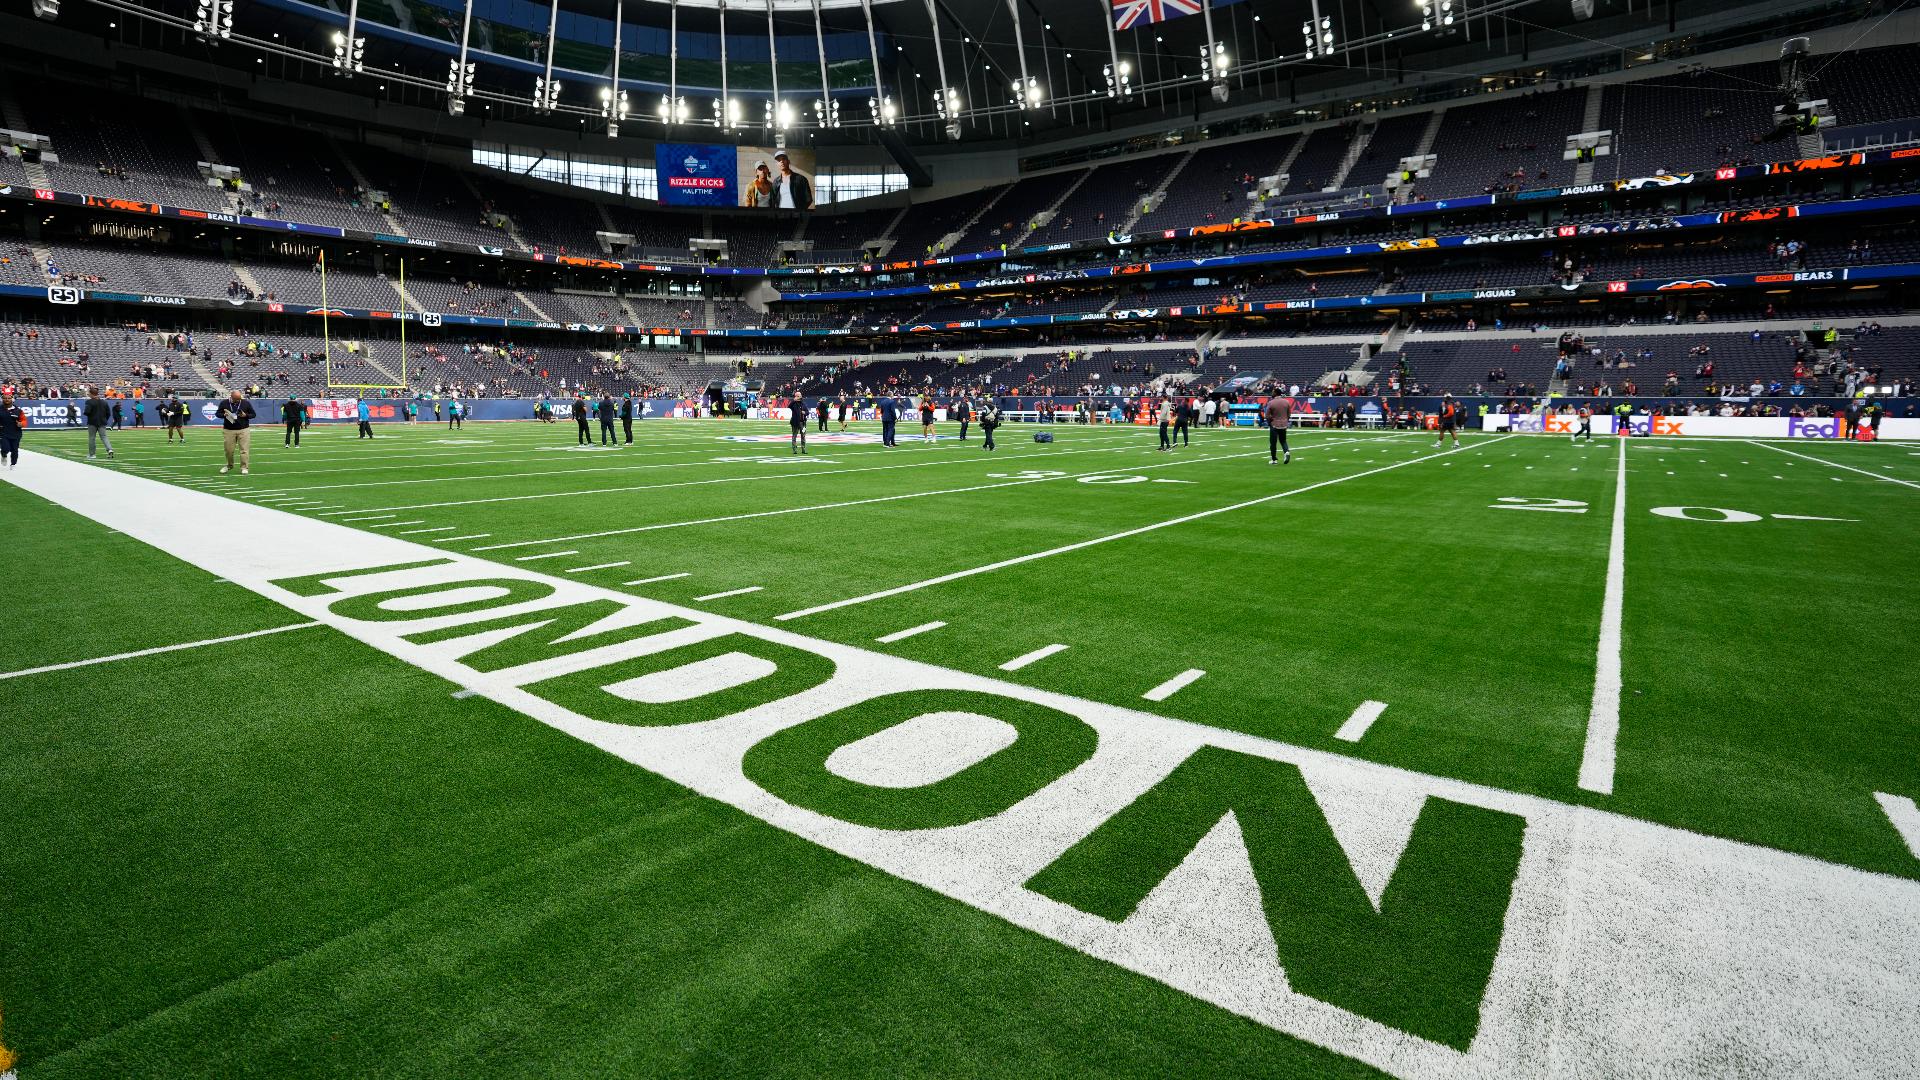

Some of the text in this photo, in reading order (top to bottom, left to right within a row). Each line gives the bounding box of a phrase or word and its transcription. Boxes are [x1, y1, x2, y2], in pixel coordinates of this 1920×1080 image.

[1892, 149, 1920, 158] CHICA
[1717, 169, 1735, 179] VS
[670, 178, 724, 187] RIZZLE KICKS
[36, 190, 54, 200] VS
[1561, 184, 1604, 196] JAGUARS
[207, 212, 234, 222] BEARS
[1316, 212, 1339, 221] BEARS
[1560, 227, 1576, 236] VS
[408, 238, 437, 247] JAGUARS
[1047, 242, 1071, 252] JAGUARS
[1794, 271, 1834, 281] BEARS
[1610, 282, 1626, 291] VS
[53, 289, 75, 302] 25
[1474, 289, 1517, 299] JAGUARS
[142, 296, 186, 305] JAGUARS
[1286, 300, 1310, 309] BEARS
[269, 303, 283, 312] VS
[392, 312, 414, 320] BEARS
[425, 313, 440, 325] 25
[1081, 312, 1107, 320] JAGUARS
[18, 404, 81, 417] erizon
[550, 404, 573, 415] VISA
[860, 407, 883, 420] FedE
[1508, 413, 1572, 432] FedEx
[1611, 415, 1683, 434] FedEx
[266, 557, 1528, 1054] LONDON
